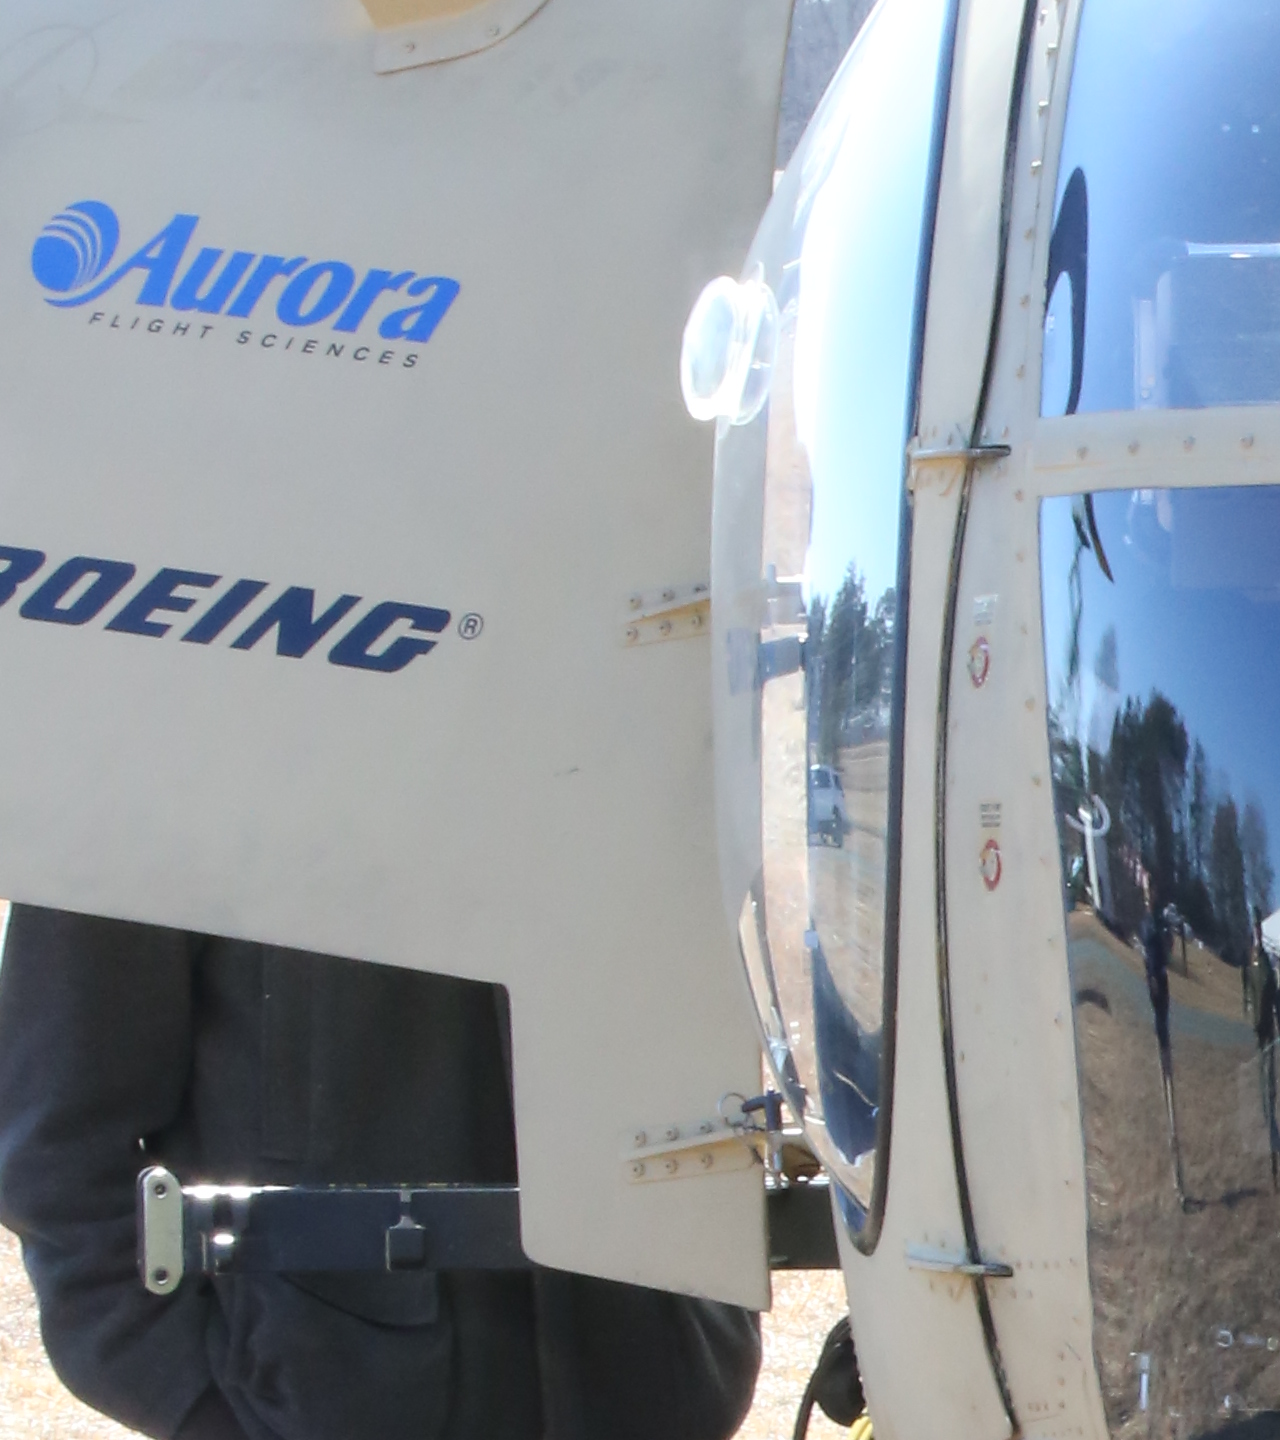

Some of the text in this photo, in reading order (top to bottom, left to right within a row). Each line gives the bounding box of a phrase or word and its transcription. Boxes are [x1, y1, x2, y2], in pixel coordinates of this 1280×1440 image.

[70, 213, 461, 344] Aurora
[88, 311, 419, 369] FLIGHT SCIENCES
